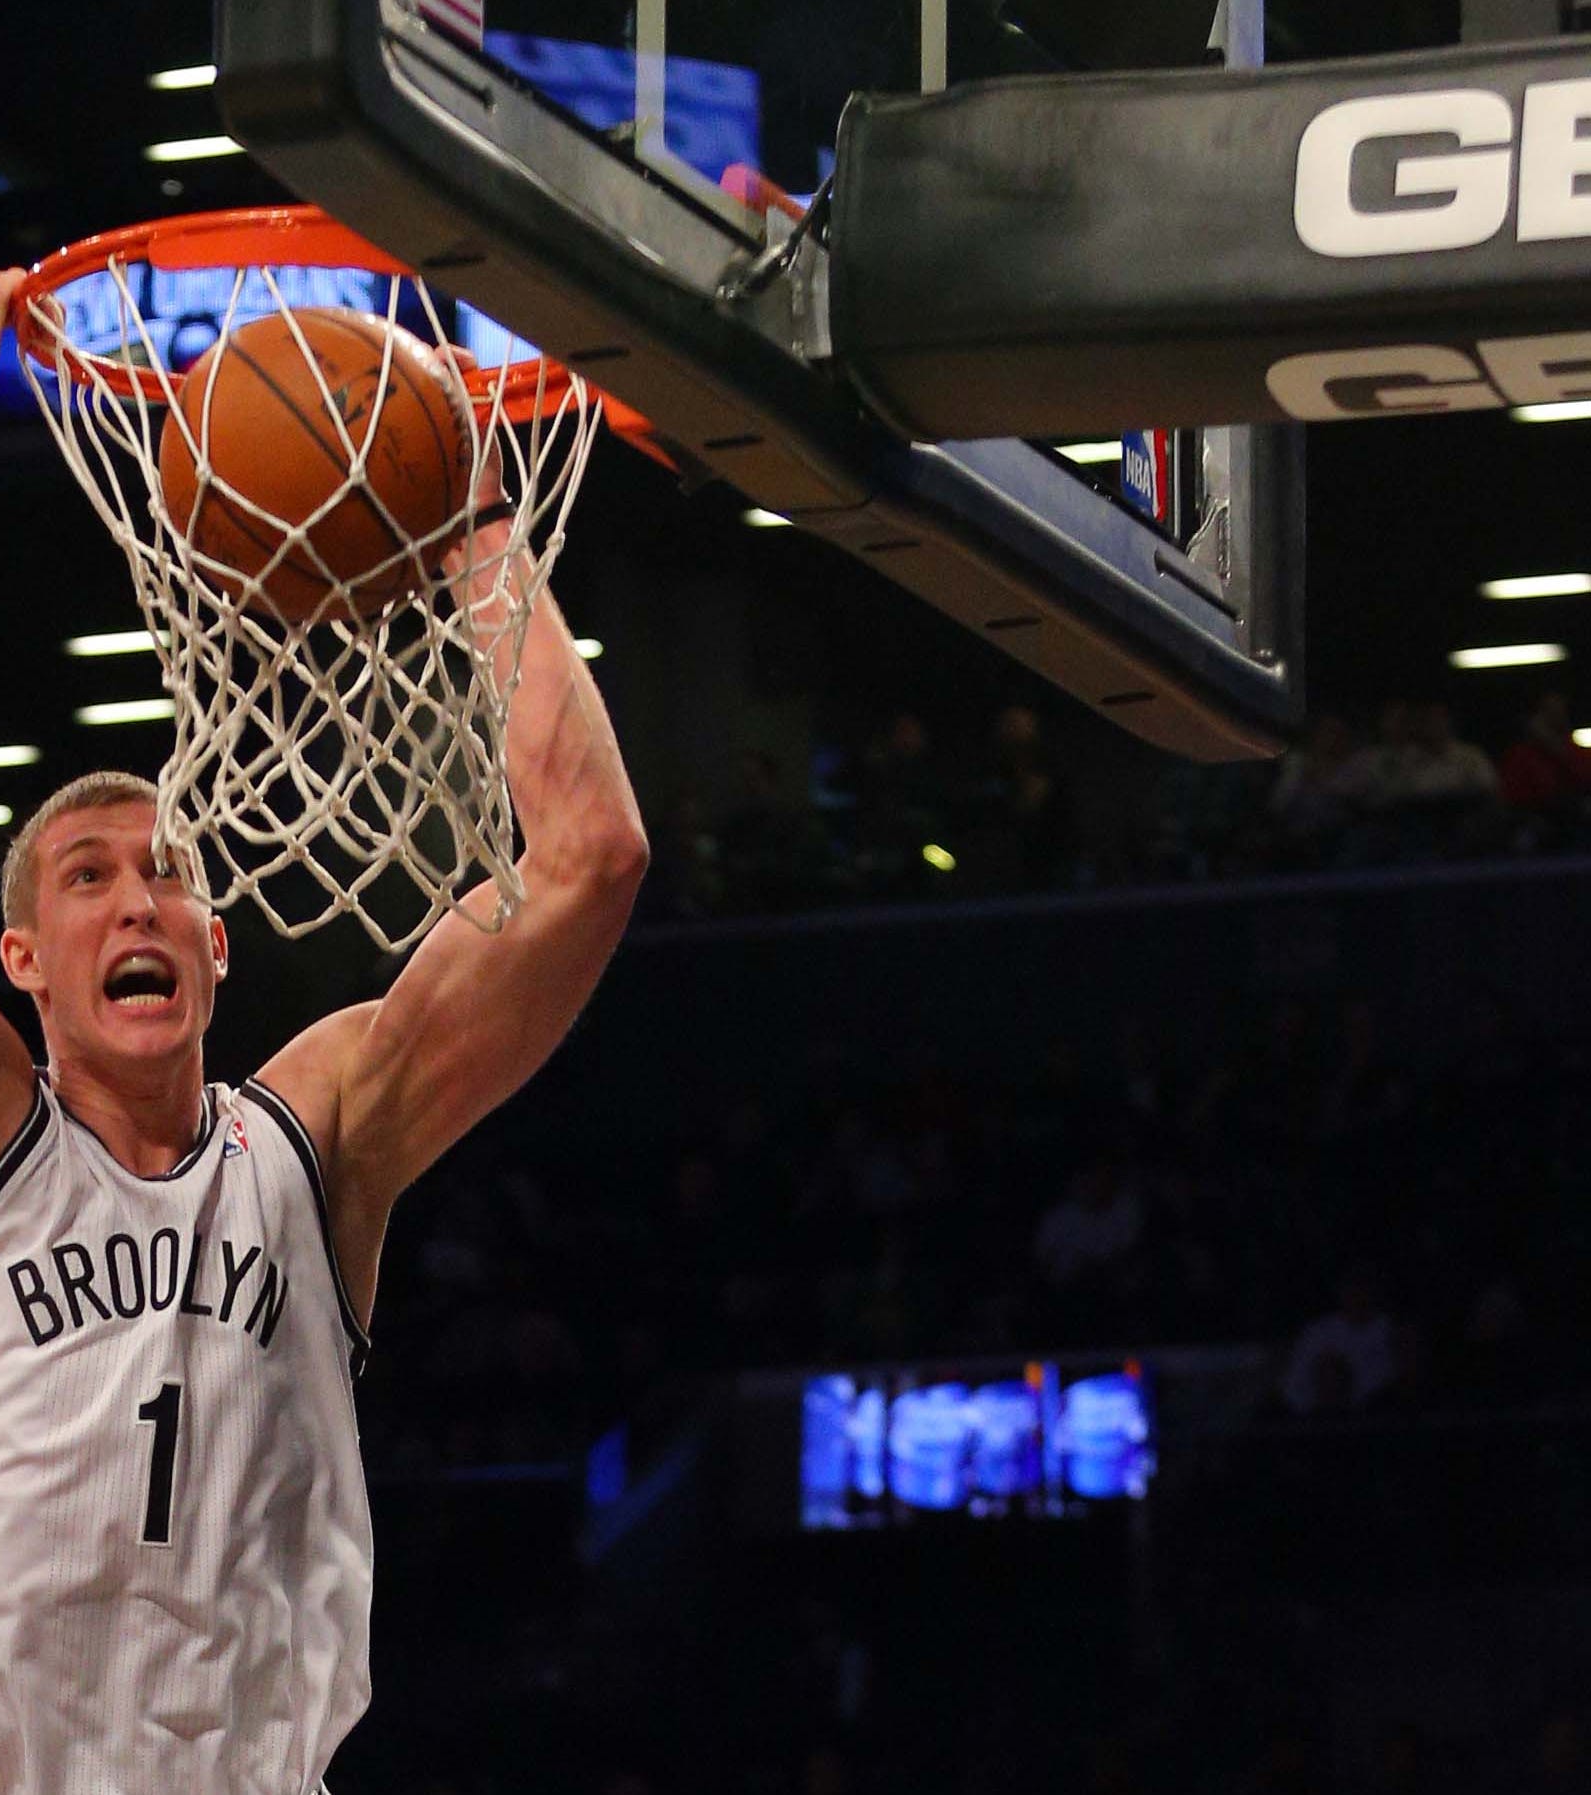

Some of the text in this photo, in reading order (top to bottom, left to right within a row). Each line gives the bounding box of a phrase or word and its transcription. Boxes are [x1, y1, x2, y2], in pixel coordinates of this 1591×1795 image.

[1126, 446, 1151, 499] NBA
[8, 1227, 288, 1349] BROOLYN
[138, 1380, 185, 1548] 1
